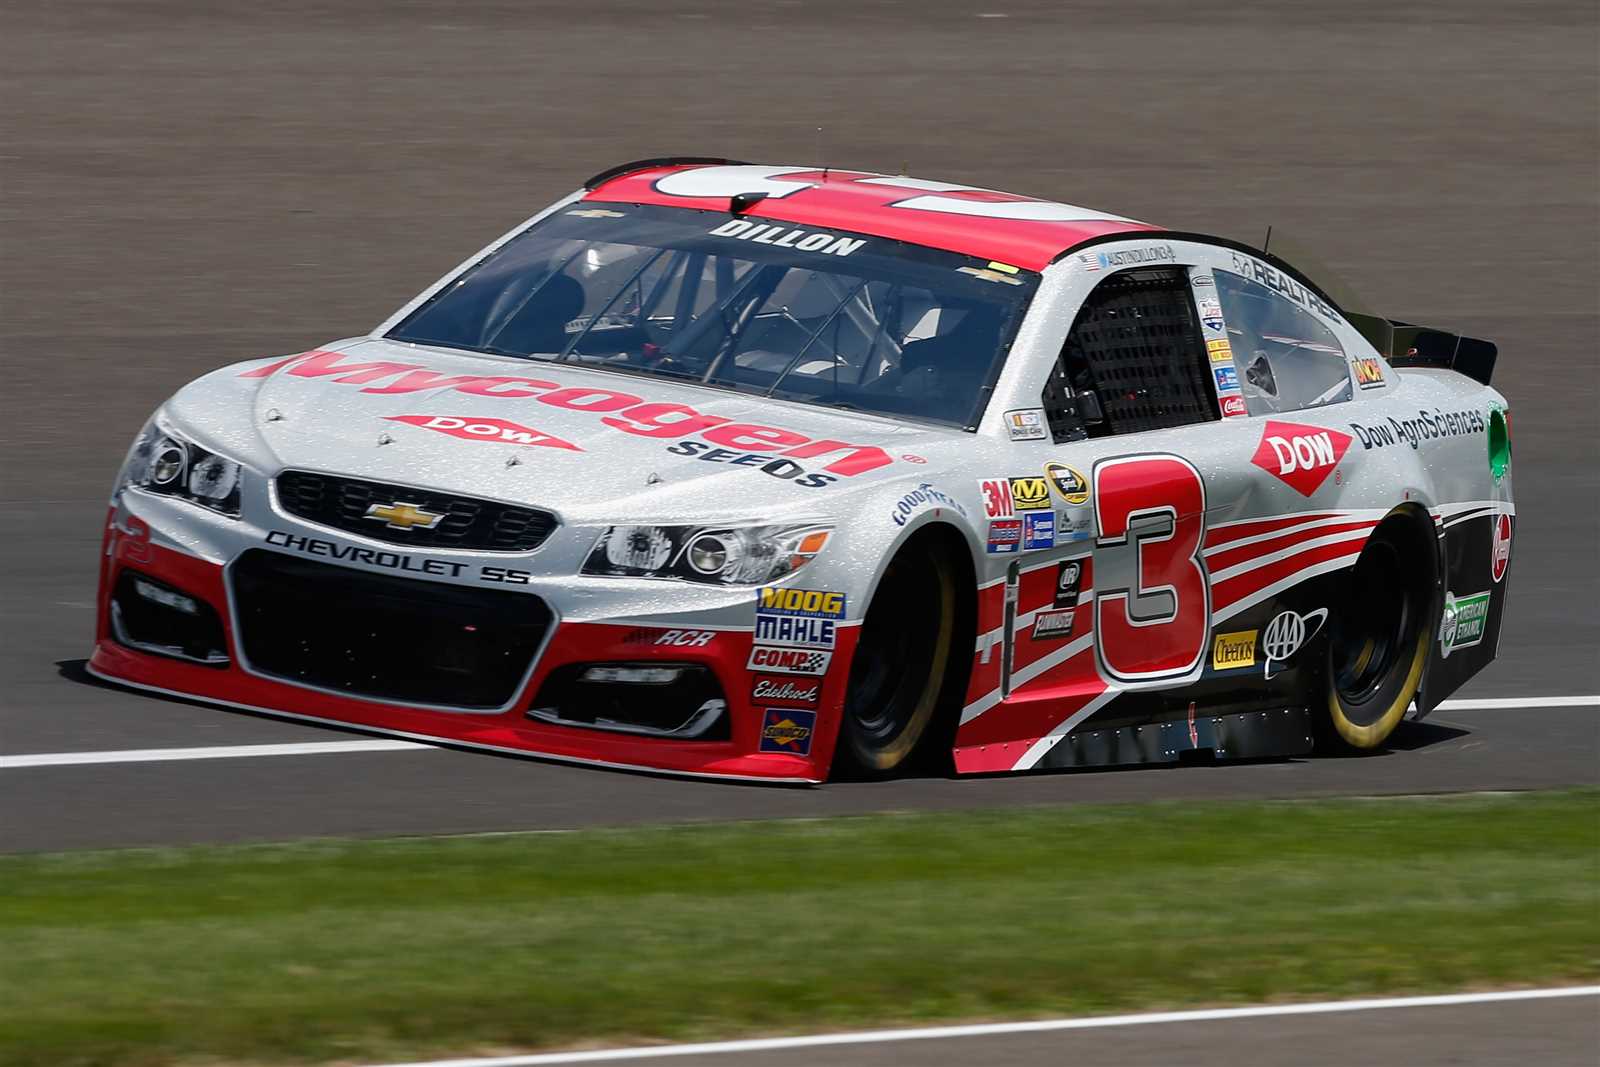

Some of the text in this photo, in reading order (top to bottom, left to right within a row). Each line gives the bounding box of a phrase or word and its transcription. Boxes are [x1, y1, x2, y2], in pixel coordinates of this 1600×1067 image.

[708, 218, 867, 257] DILLON
[1252, 259, 1343, 325] REALTREE
[240, 350, 894, 476] Mycogen
[427, 415, 548, 446] DOW
[1348, 407, 1485, 450] Dow AgroSciences
[667, 440, 838, 488] SEEDS
[1266, 431, 1336, 476] DOW
[981, 480, 1013, 517] 3M
[265, 530, 531, 585] CHEVROLET SS
[1094, 454, 1208, 680] 3
[761, 587, 844, 614] MOOG
[654, 629, 717, 647] RCR
[756, 616, 834, 643] MAHLE
[1265, 614, 1305, 652] AAA
[752, 649, 809, 668] COMP
[1214, 637, 1254, 663] Cheerios
[752, 679, 817, 702] Edelbrock
